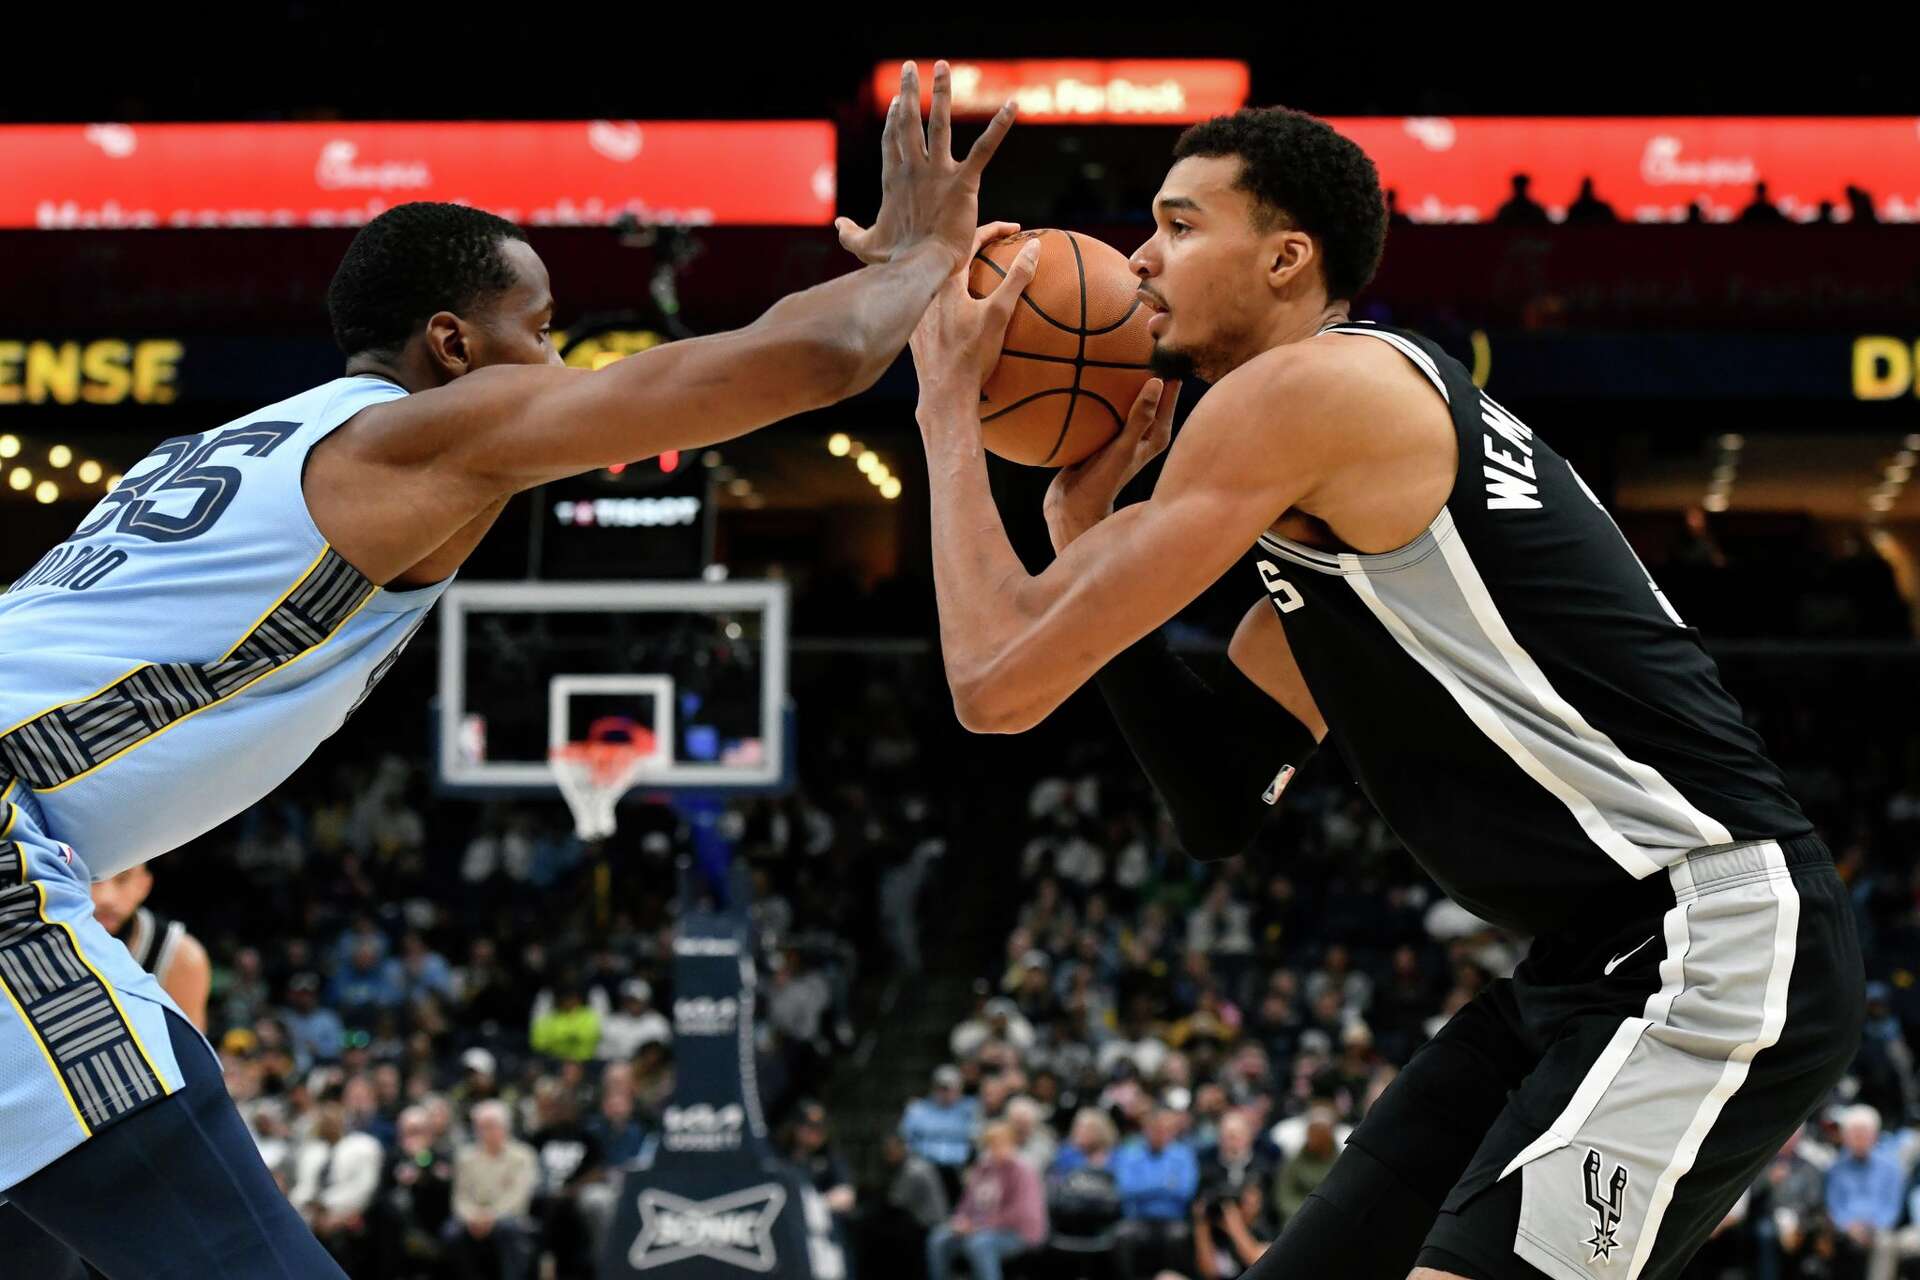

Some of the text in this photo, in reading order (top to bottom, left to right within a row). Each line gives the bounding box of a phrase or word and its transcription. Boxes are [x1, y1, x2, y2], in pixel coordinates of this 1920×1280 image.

[1852, 336, 1920, 401] D
[64, 421, 303, 543] 35
[1480, 388, 1543, 510] WEM
